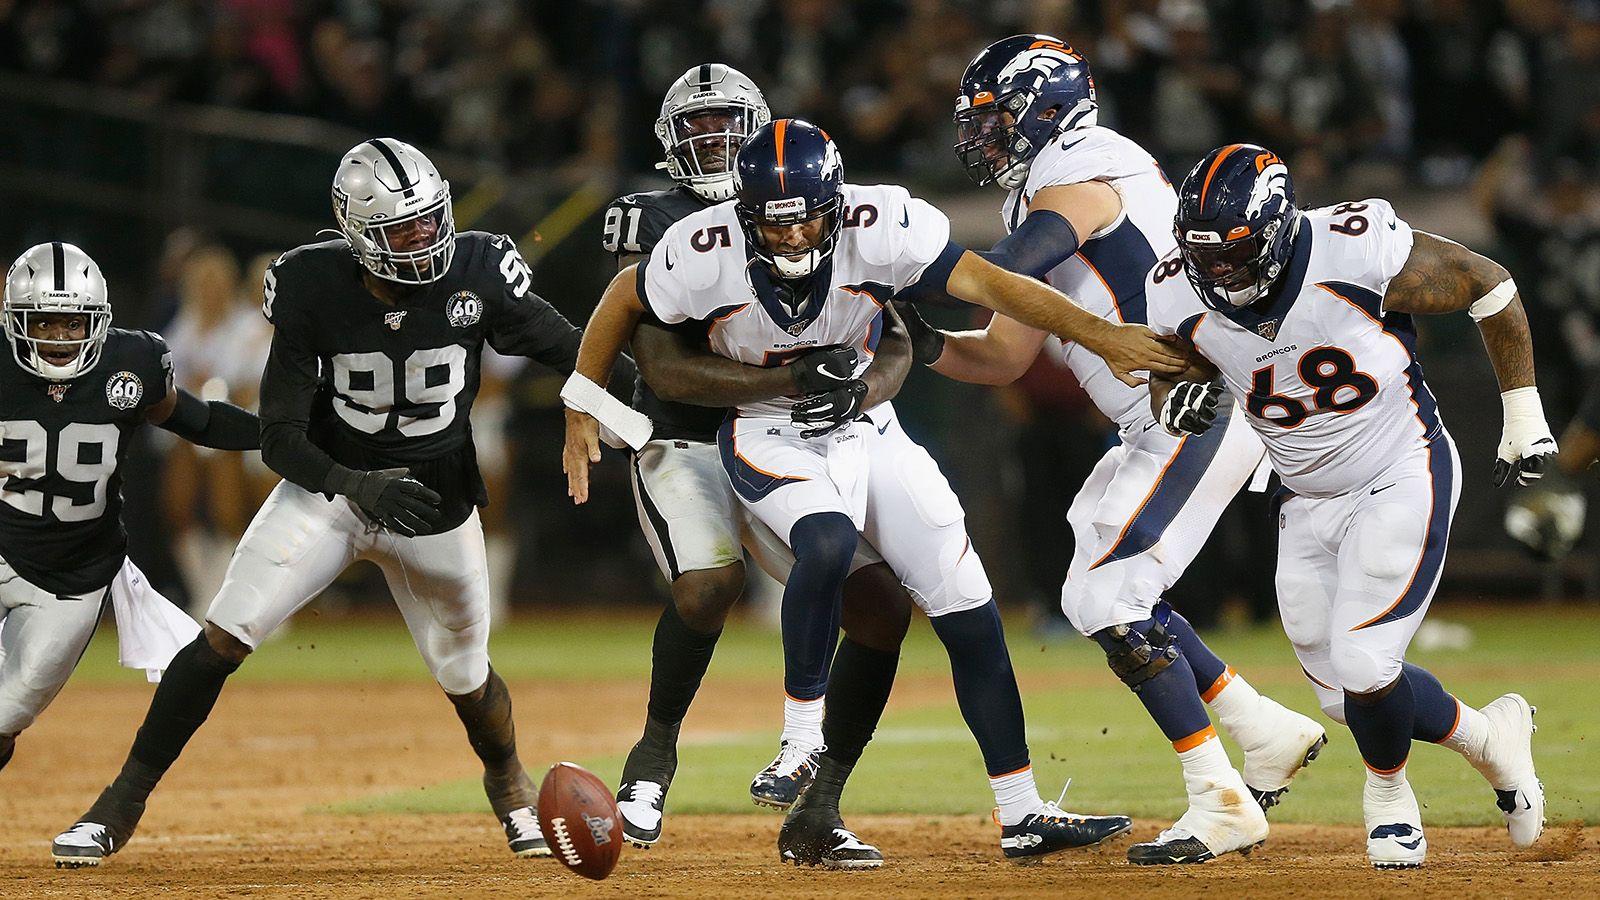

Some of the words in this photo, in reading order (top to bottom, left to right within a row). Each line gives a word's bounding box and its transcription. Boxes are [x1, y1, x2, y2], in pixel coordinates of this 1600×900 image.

[774, 200, 797, 210] BRONCOS
[841, 203, 879, 229] 5
[602, 207, 643, 252] 91
[690, 225, 733, 254] 5
[452, 299, 478, 319] 60
[773, 339, 819, 349] BRONCOS
[1255, 344, 1299, 363] BRONCOS
[111, 379, 138, 400] 60
[331, 343, 468, 438] 99
[1246, 345, 1380, 430] 68
[0, 420, 120, 522] 29
